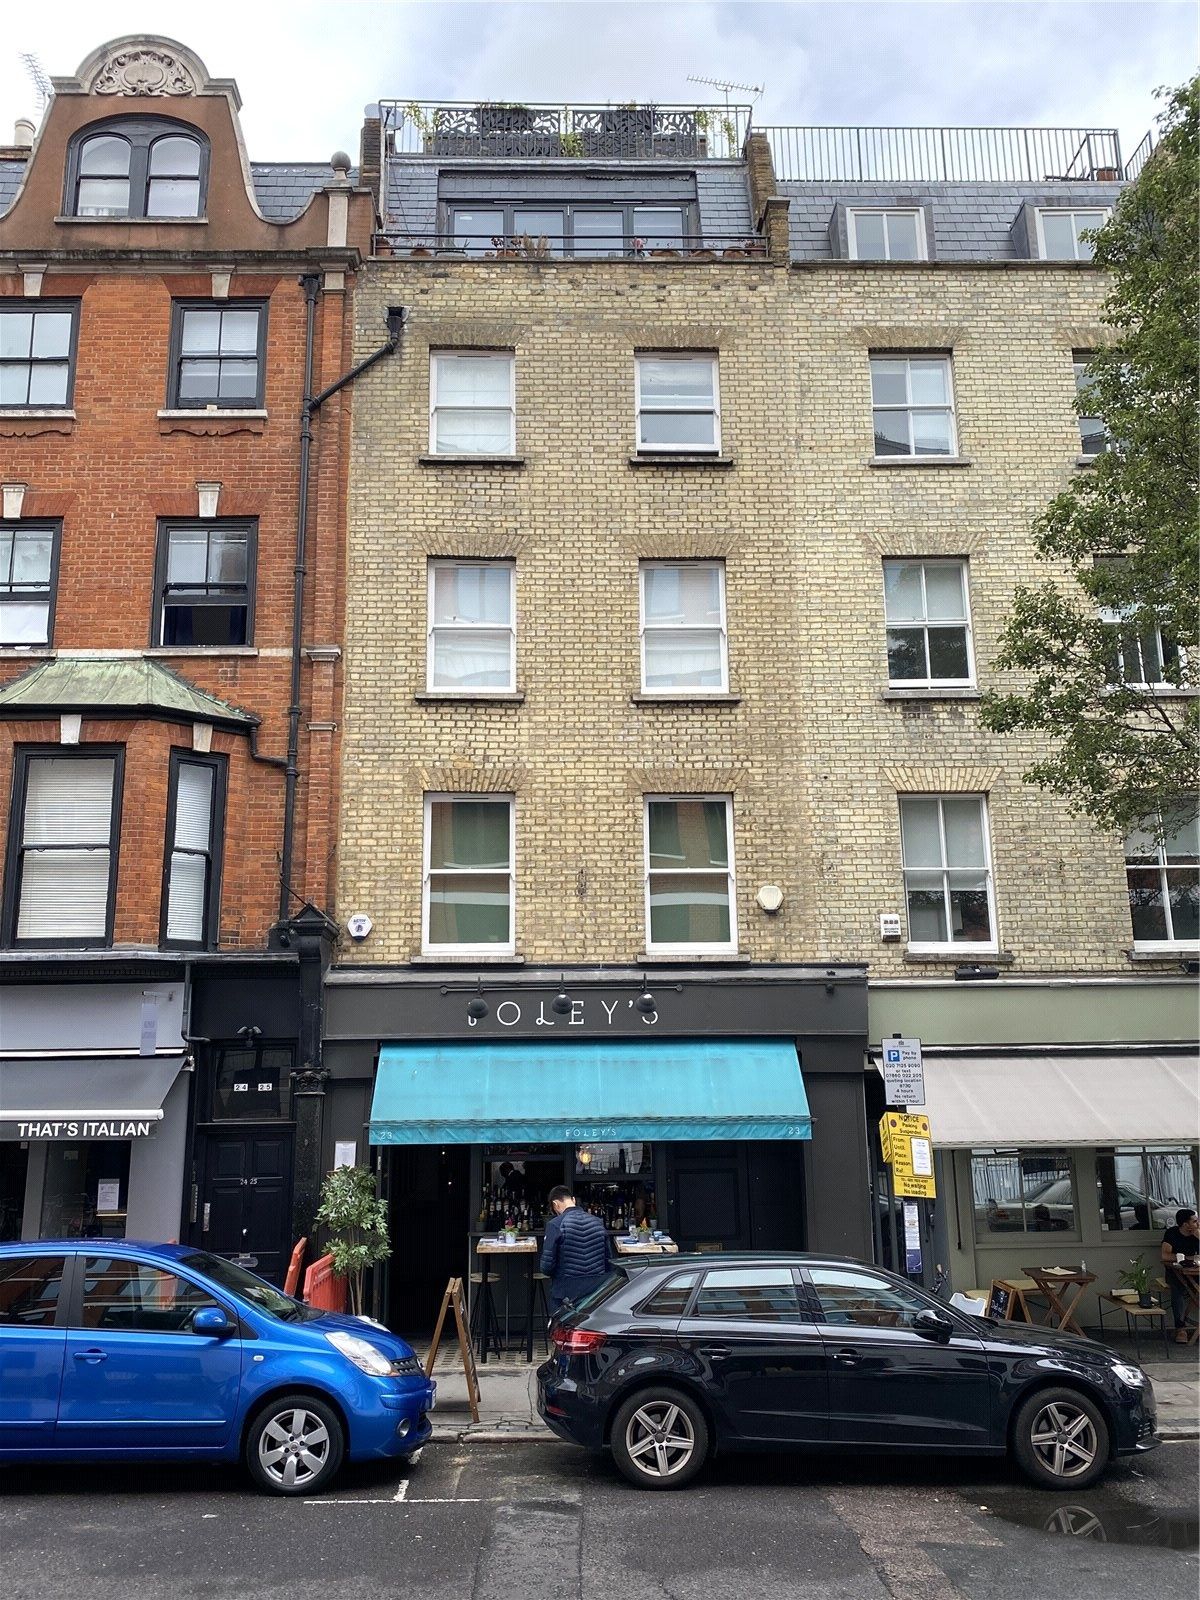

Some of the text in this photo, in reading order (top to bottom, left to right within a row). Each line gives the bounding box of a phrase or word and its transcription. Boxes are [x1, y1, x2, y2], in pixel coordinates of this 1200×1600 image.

[898, 1114, 919, 1123] NOTICE
[17, 1122, 150, 1137] THAT'S ITALIAN
[380, 1126, 800, 1140] 23 FOLEY'S 23
